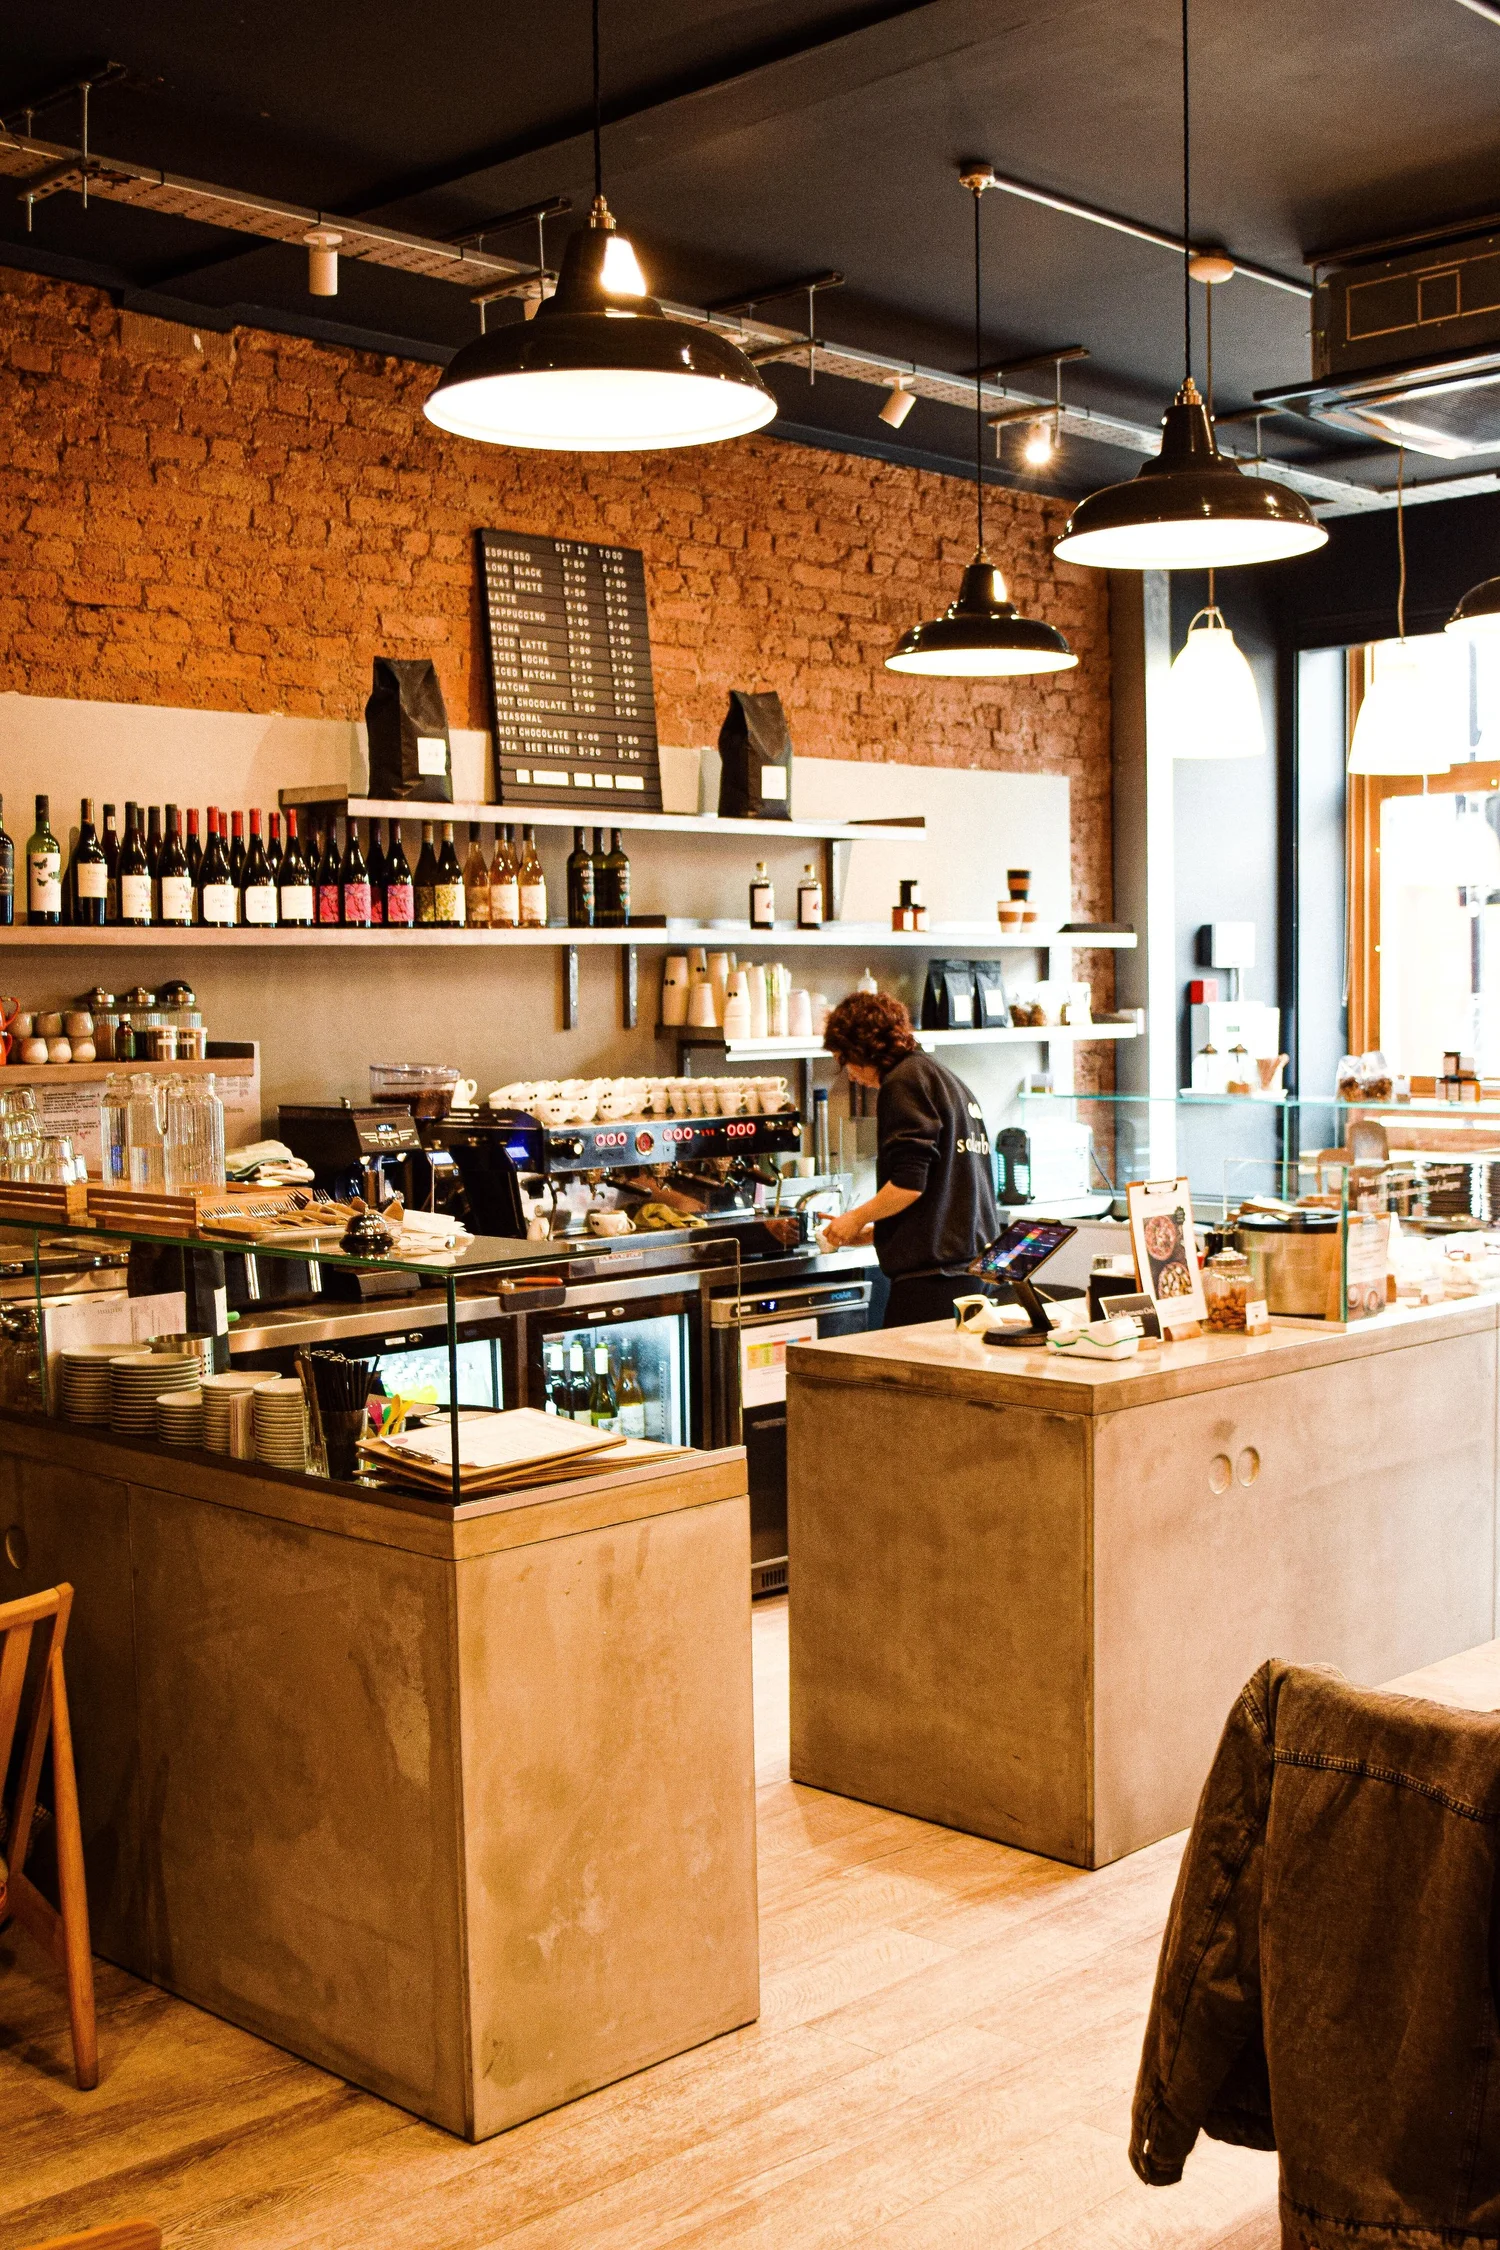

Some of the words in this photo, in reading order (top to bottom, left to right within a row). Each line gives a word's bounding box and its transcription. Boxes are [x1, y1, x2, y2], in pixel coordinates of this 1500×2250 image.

[485, 547, 530, 562] ESPRESSO
[555, 543, 571, 553] SIT
[578, 546, 589, 556] IN
[486, 561, 508, 572] LONG
[514, 566, 542, 578] BLACK
[487, 576, 509, 588] FLAT
[514, 580, 542, 592] WHITE
[488, 592, 517, 603] LATTE
[489, 607, 546, 622] CAPPUCCINO
[490, 622, 519, 633] MOCHA
[492, 636, 515, 646] ICED
[520, 640, 547, 651] LATTE
[493, 651, 516, 662] ICED
[521, 654, 549, 665] MOCHA
[495, 666, 518, 677] ICED
[522, 669, 556, 680] MATCHA
[496, 682, 530, 692] MATCHA
[497, 696, 514, 706] HOT
[517, 698, 567, 710] CHOCOLATE
[498, 711, 542, 723] SEASONAL
[499, 726, 516, 735] HOT
[519, 727, 568, 740] CHOCOLATE
[501, 741, 517, 750] TEA
[525, 742, 542, 752] SEE
[547, 744, 570, 754] MENU
